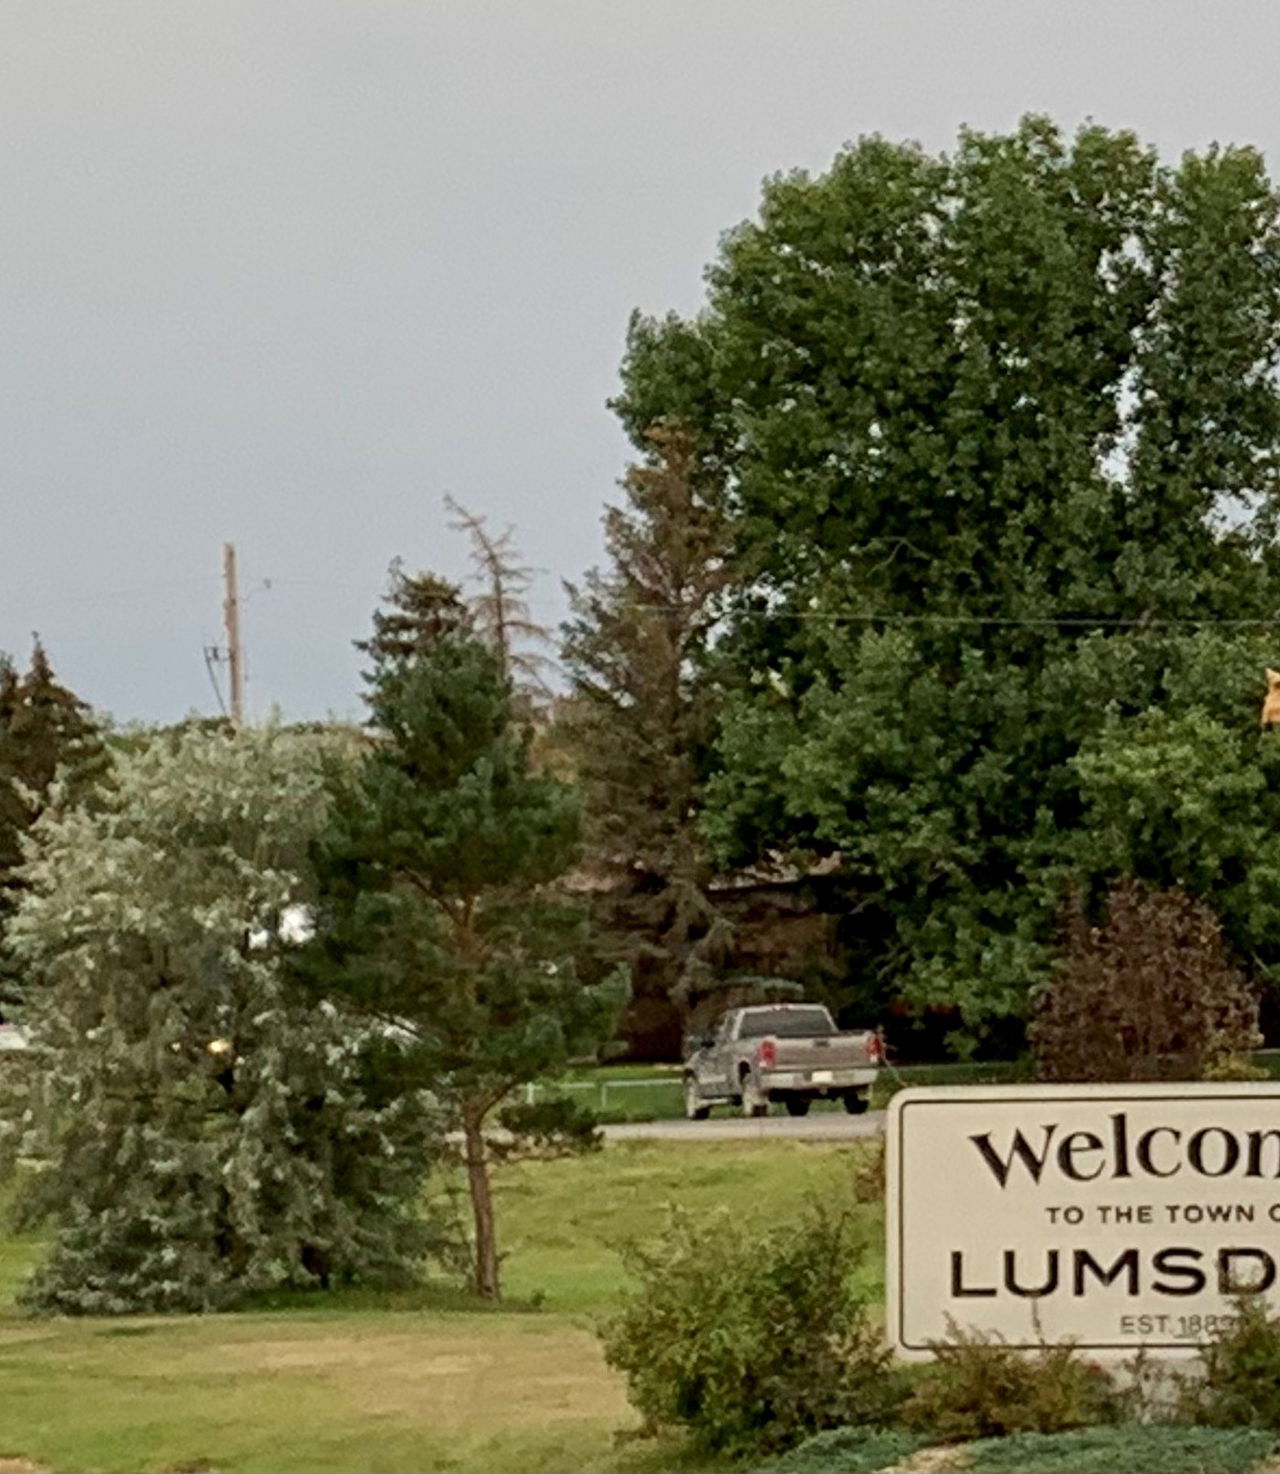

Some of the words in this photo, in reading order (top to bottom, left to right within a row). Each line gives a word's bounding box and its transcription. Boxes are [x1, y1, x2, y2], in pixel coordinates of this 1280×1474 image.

[1045, 1206, 1085, 1225] TO
[1097, 1205, 1153, 1224] THE
[1165, 1204, 1254, 1224] TOWN
